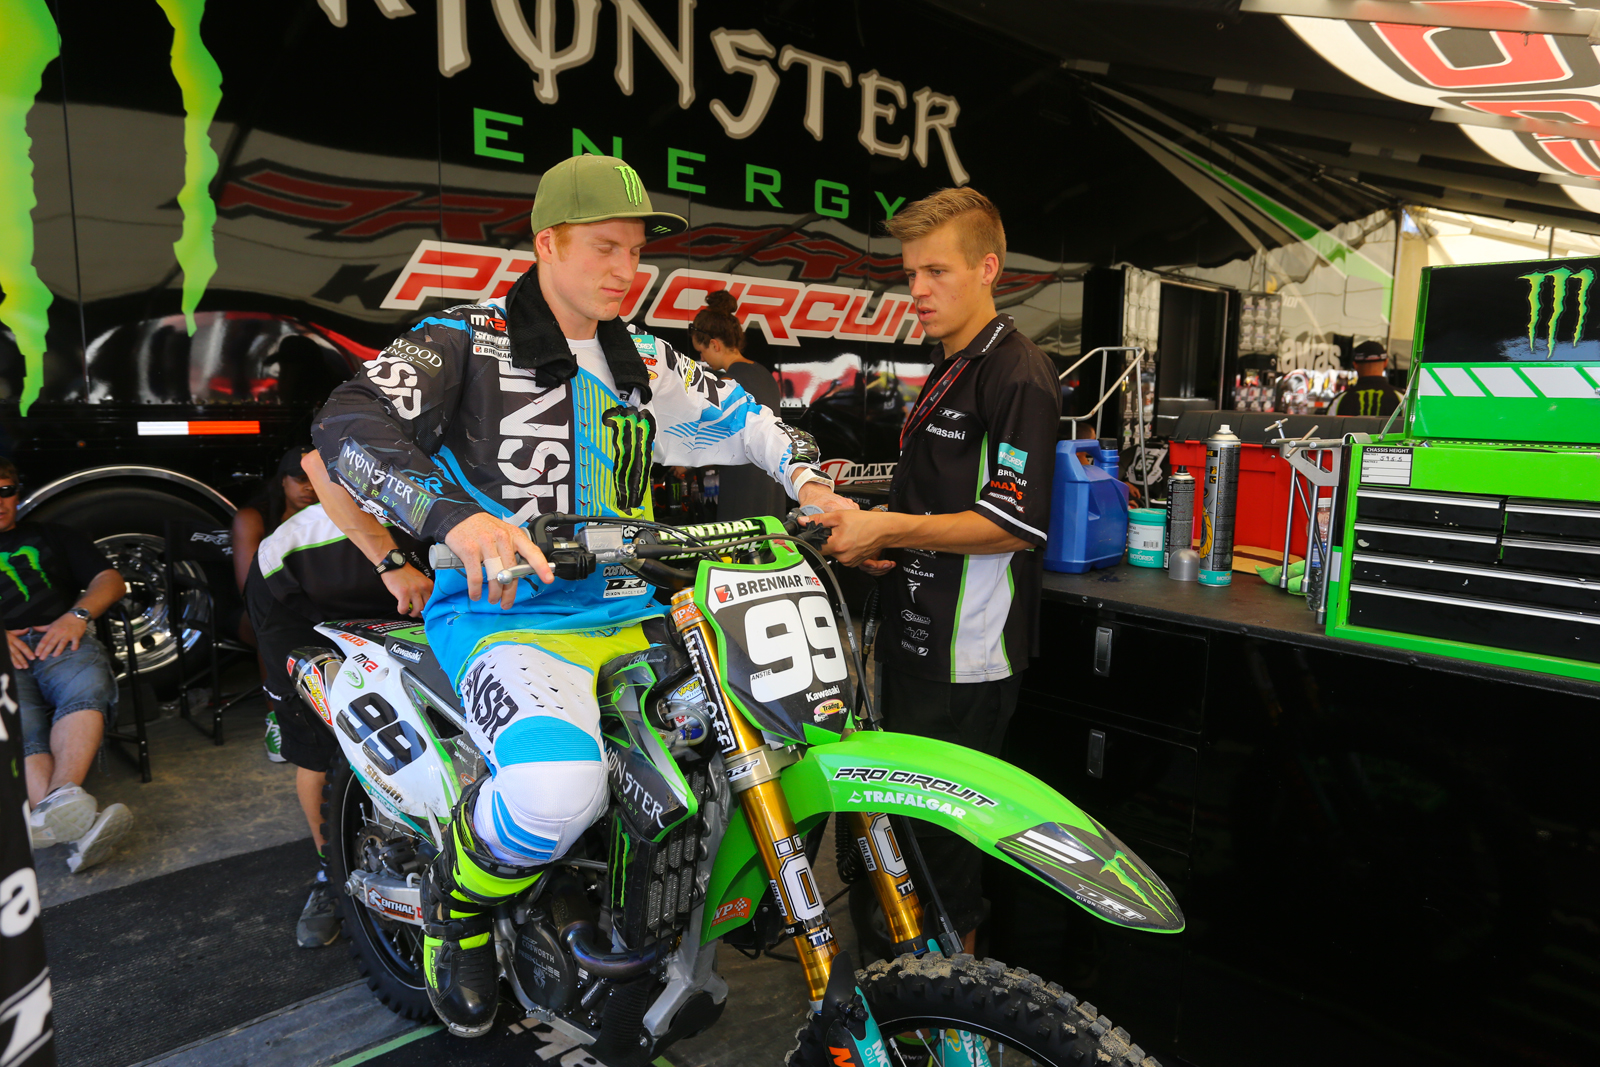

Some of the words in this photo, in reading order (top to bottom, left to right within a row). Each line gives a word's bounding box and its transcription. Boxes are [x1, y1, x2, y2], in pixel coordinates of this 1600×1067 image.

[473, 107, 906, 229] ENERGY
[1277, 337, 1342, 374] awas
[498, 360, 571, 531] NSR
[925, 423, 967, 441] Kawasaki
[343, 445, 414, 505] MONSTER
[348, 470, 398, 509] ENERGY
[736, 574, 804, 597] BRENMAR
[337, 632, 369, 647] MAXXIS
[390, 643, 425, 662] Kawasaki
[744, 595, 848, 704] 99
[751, 670, 772, 681] ANSTIE
[805, 685, 841, 703] Kawasaki
[336, 692, 428, 776] 99
[833, 767, 889, 783] PRO
[887, 770, 999, 807] CIRCUIT
[864, 790, 967, 819] TRAFALGAR
[1075, 894, 1097, 907] DIXON
[807, 926, 834, 947] TTX
